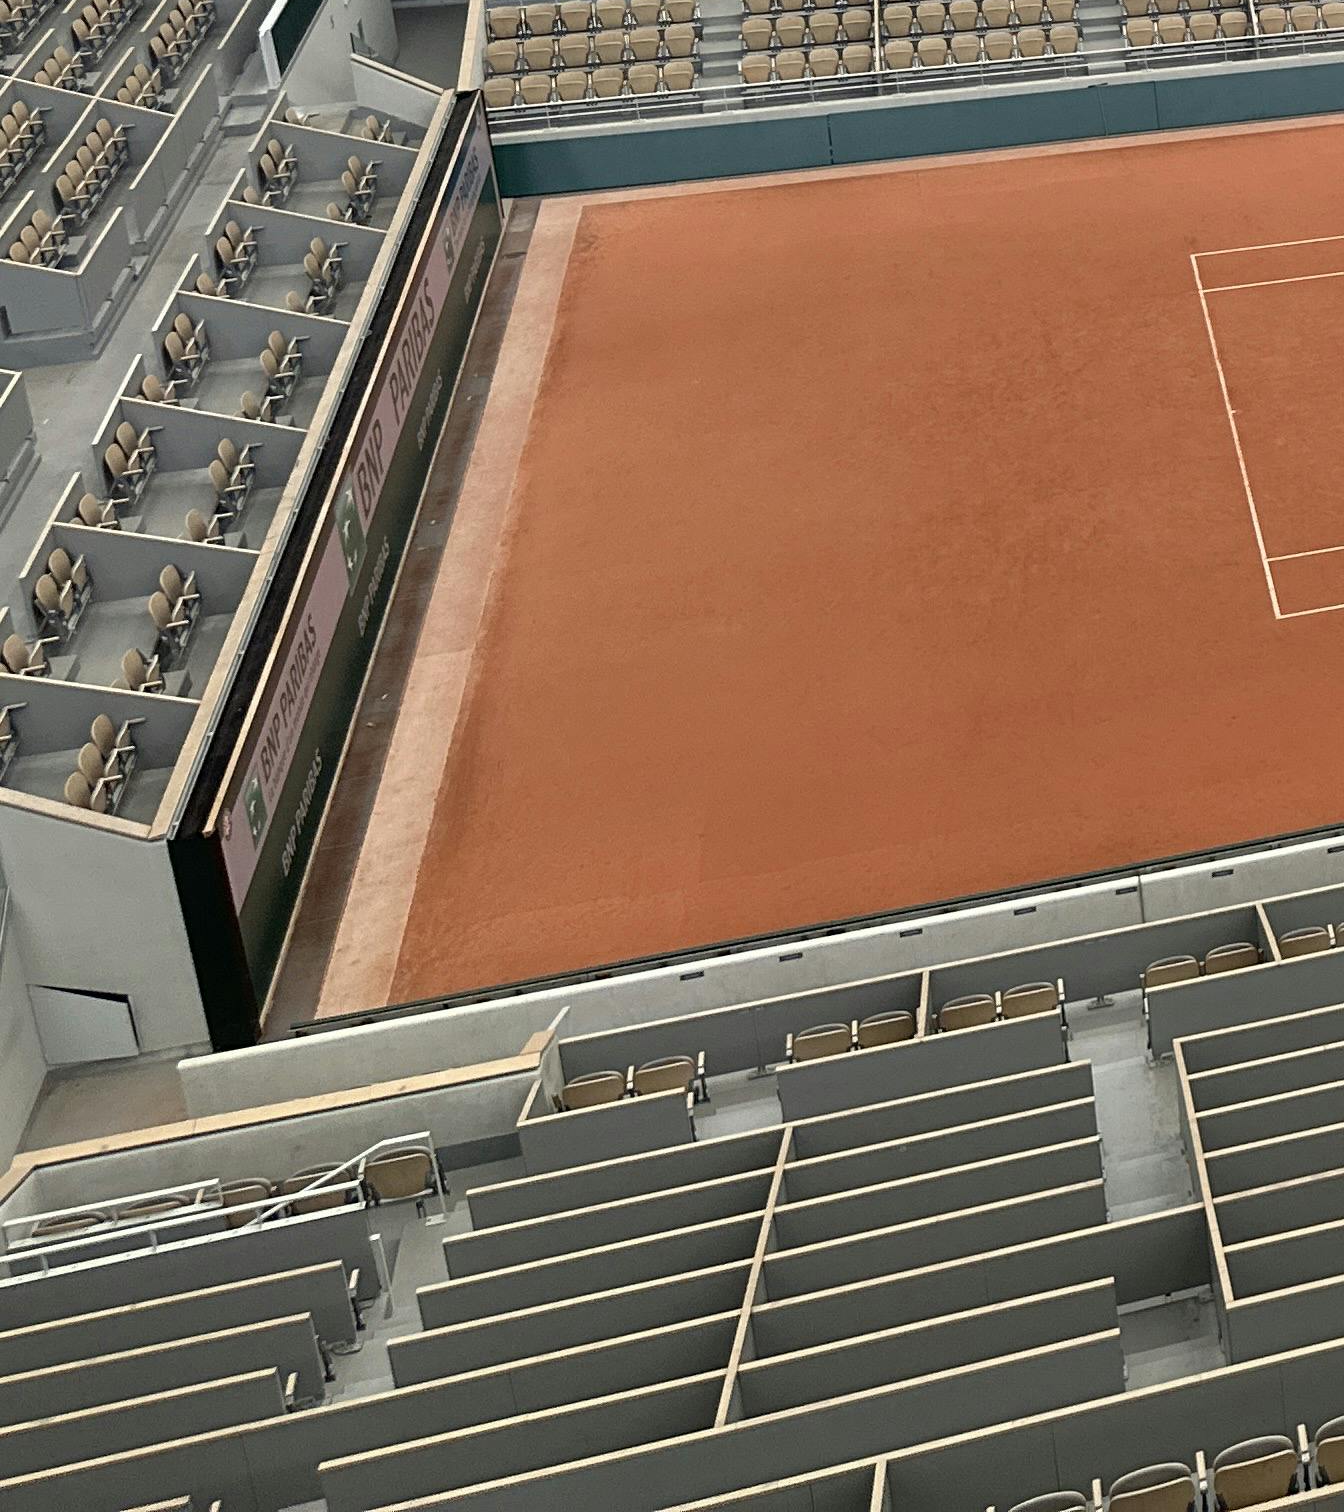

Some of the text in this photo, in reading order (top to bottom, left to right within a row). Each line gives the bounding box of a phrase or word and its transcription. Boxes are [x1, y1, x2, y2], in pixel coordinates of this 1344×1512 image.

[356, 418, 386, 521] BNP
[389, 277, 436, 427] PARIBAS
[259, 713, 284, 784] BNP
[279, 612, 319, 731] PARIBAS
